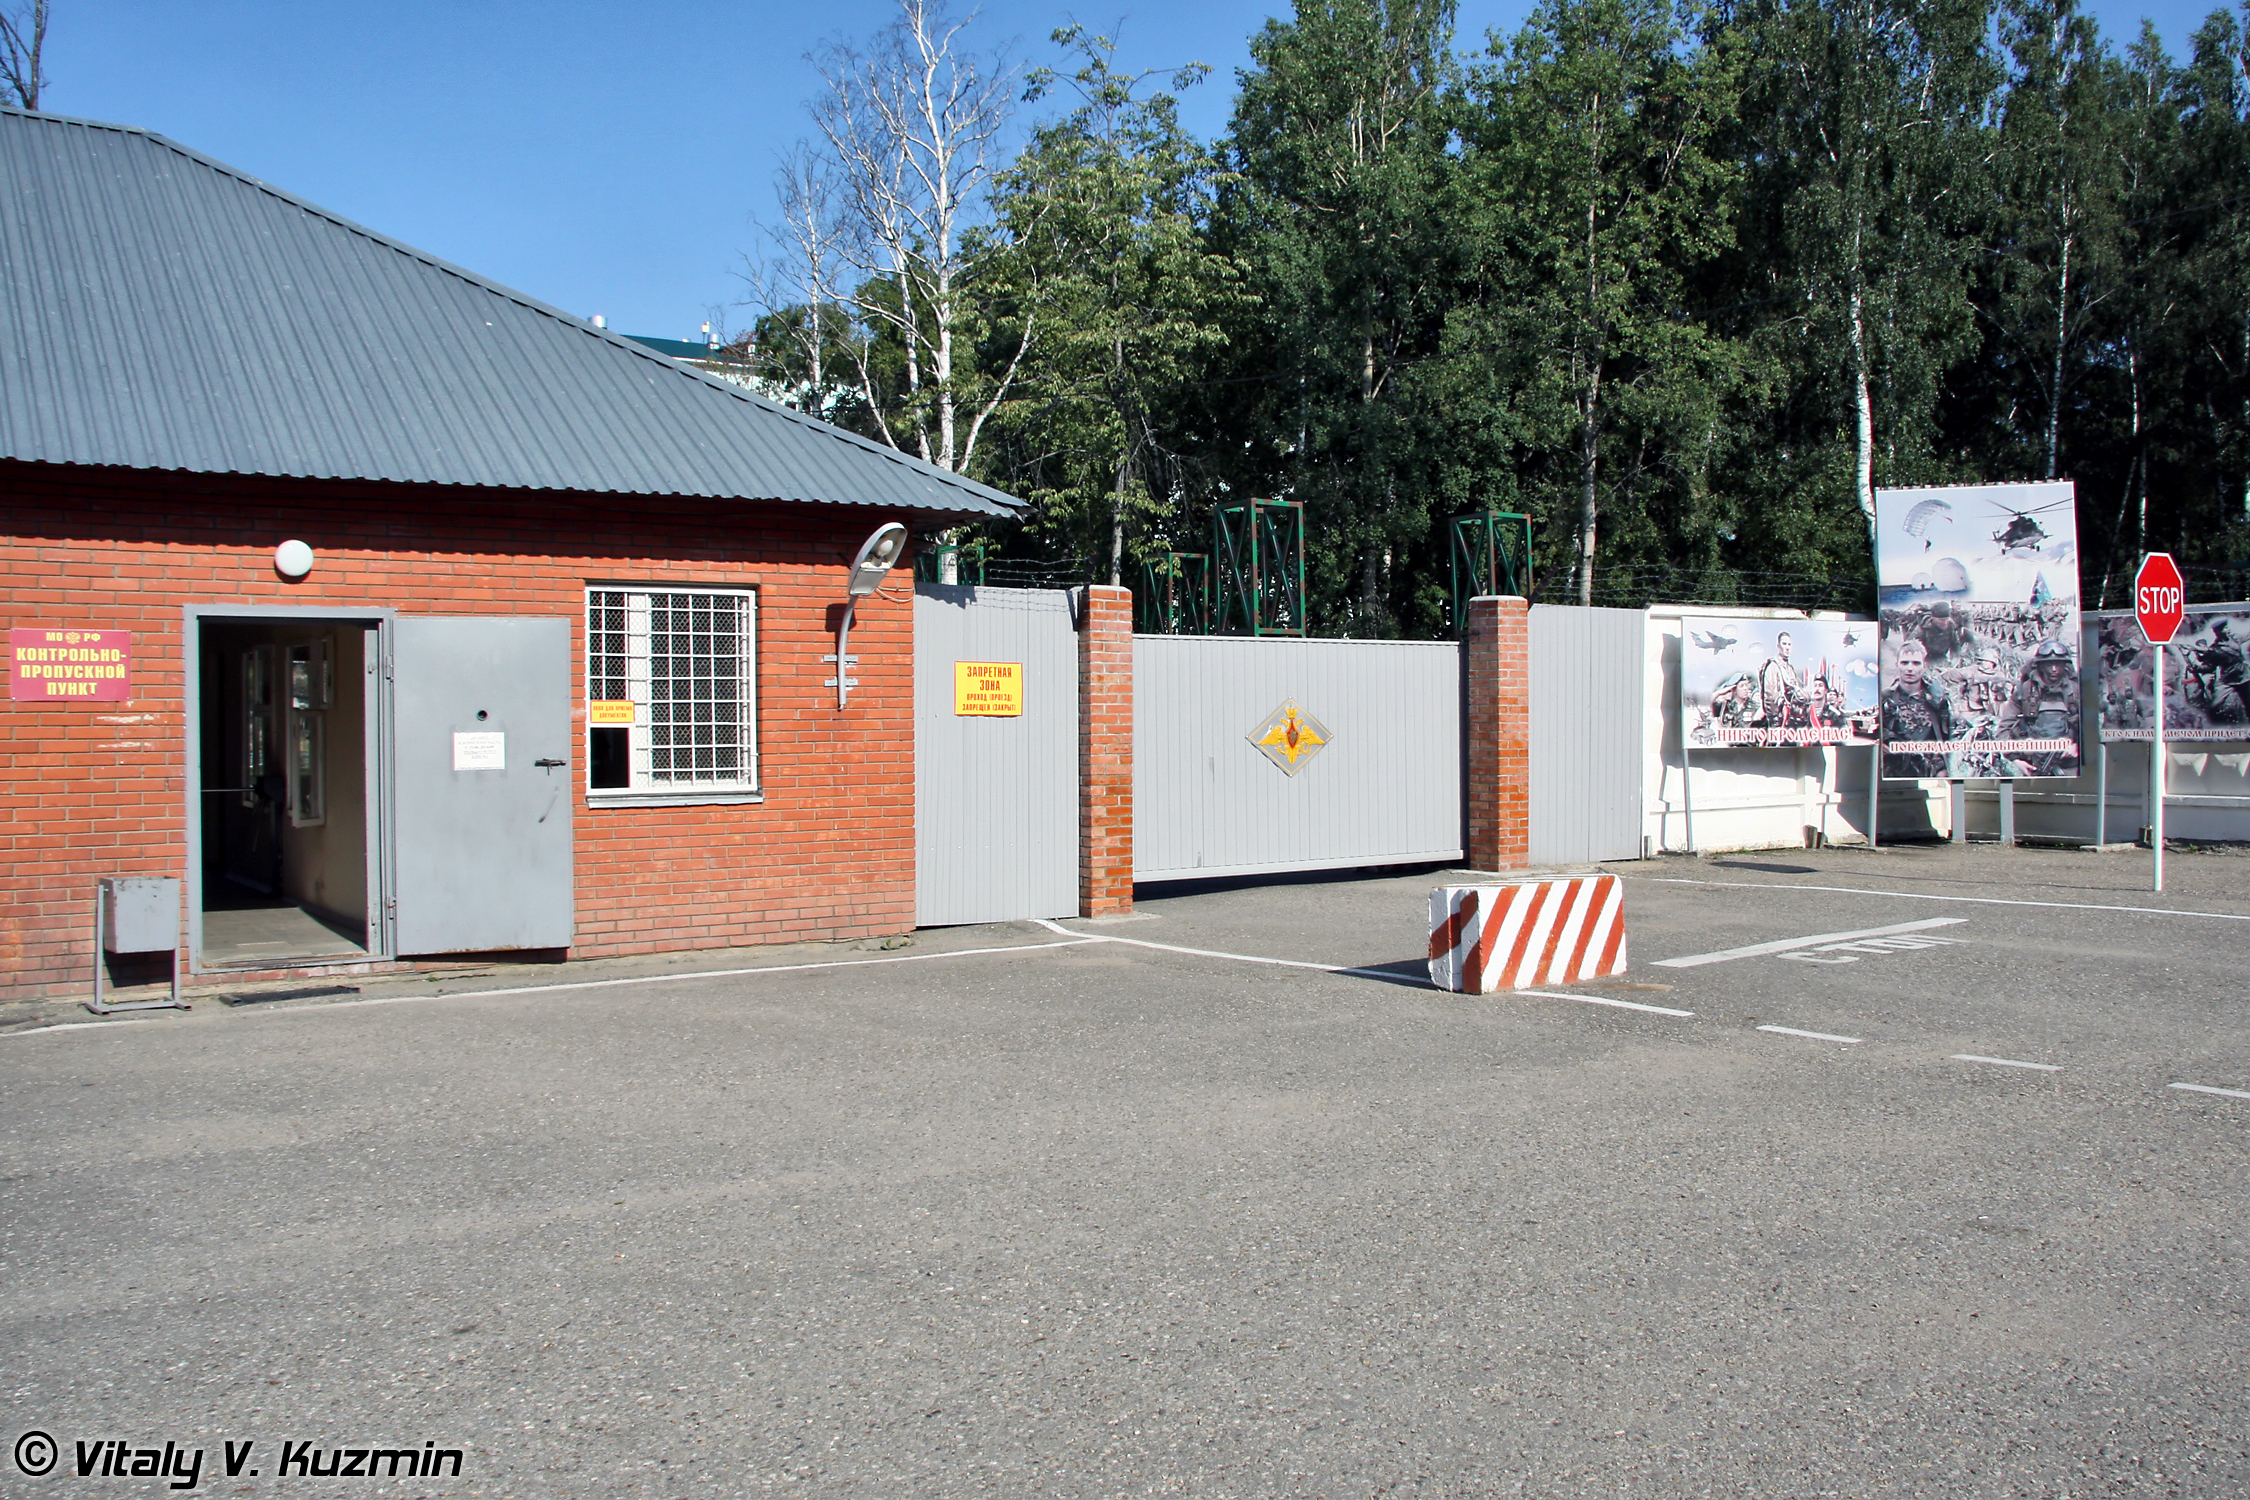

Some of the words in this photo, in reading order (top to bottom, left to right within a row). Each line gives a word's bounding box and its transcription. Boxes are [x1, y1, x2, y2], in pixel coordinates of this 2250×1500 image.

[2140, 586, 2180, 614] STOP
[46, 632, 63, 642] МО
[84, 632, 101, 642] РФ
[16, 648, 127, 661] КОНТРОЛЬНО-
[20, 664, 126, 678] ПРОПУСКНОЙ
[966, 666, 1012, 678] ЗАПРЕТНАЯ
[47, 682, 98, 695] ПУНКТ
[979, 680, 1001, 691] ЗОНА
[966, 693, 988, 701] ПРОХОД
[1717, 729, 1767, 742] НИКТО
[1769, 728, 1819, 742] КРОМЕ
[1821, 727, 1853, 741] НАС!
[1889, 741, 1970, 752] ПОБЕЖДАЕТ
[1972, 739, 2072, 752] СИЛЬНЕЙШИЙ!
